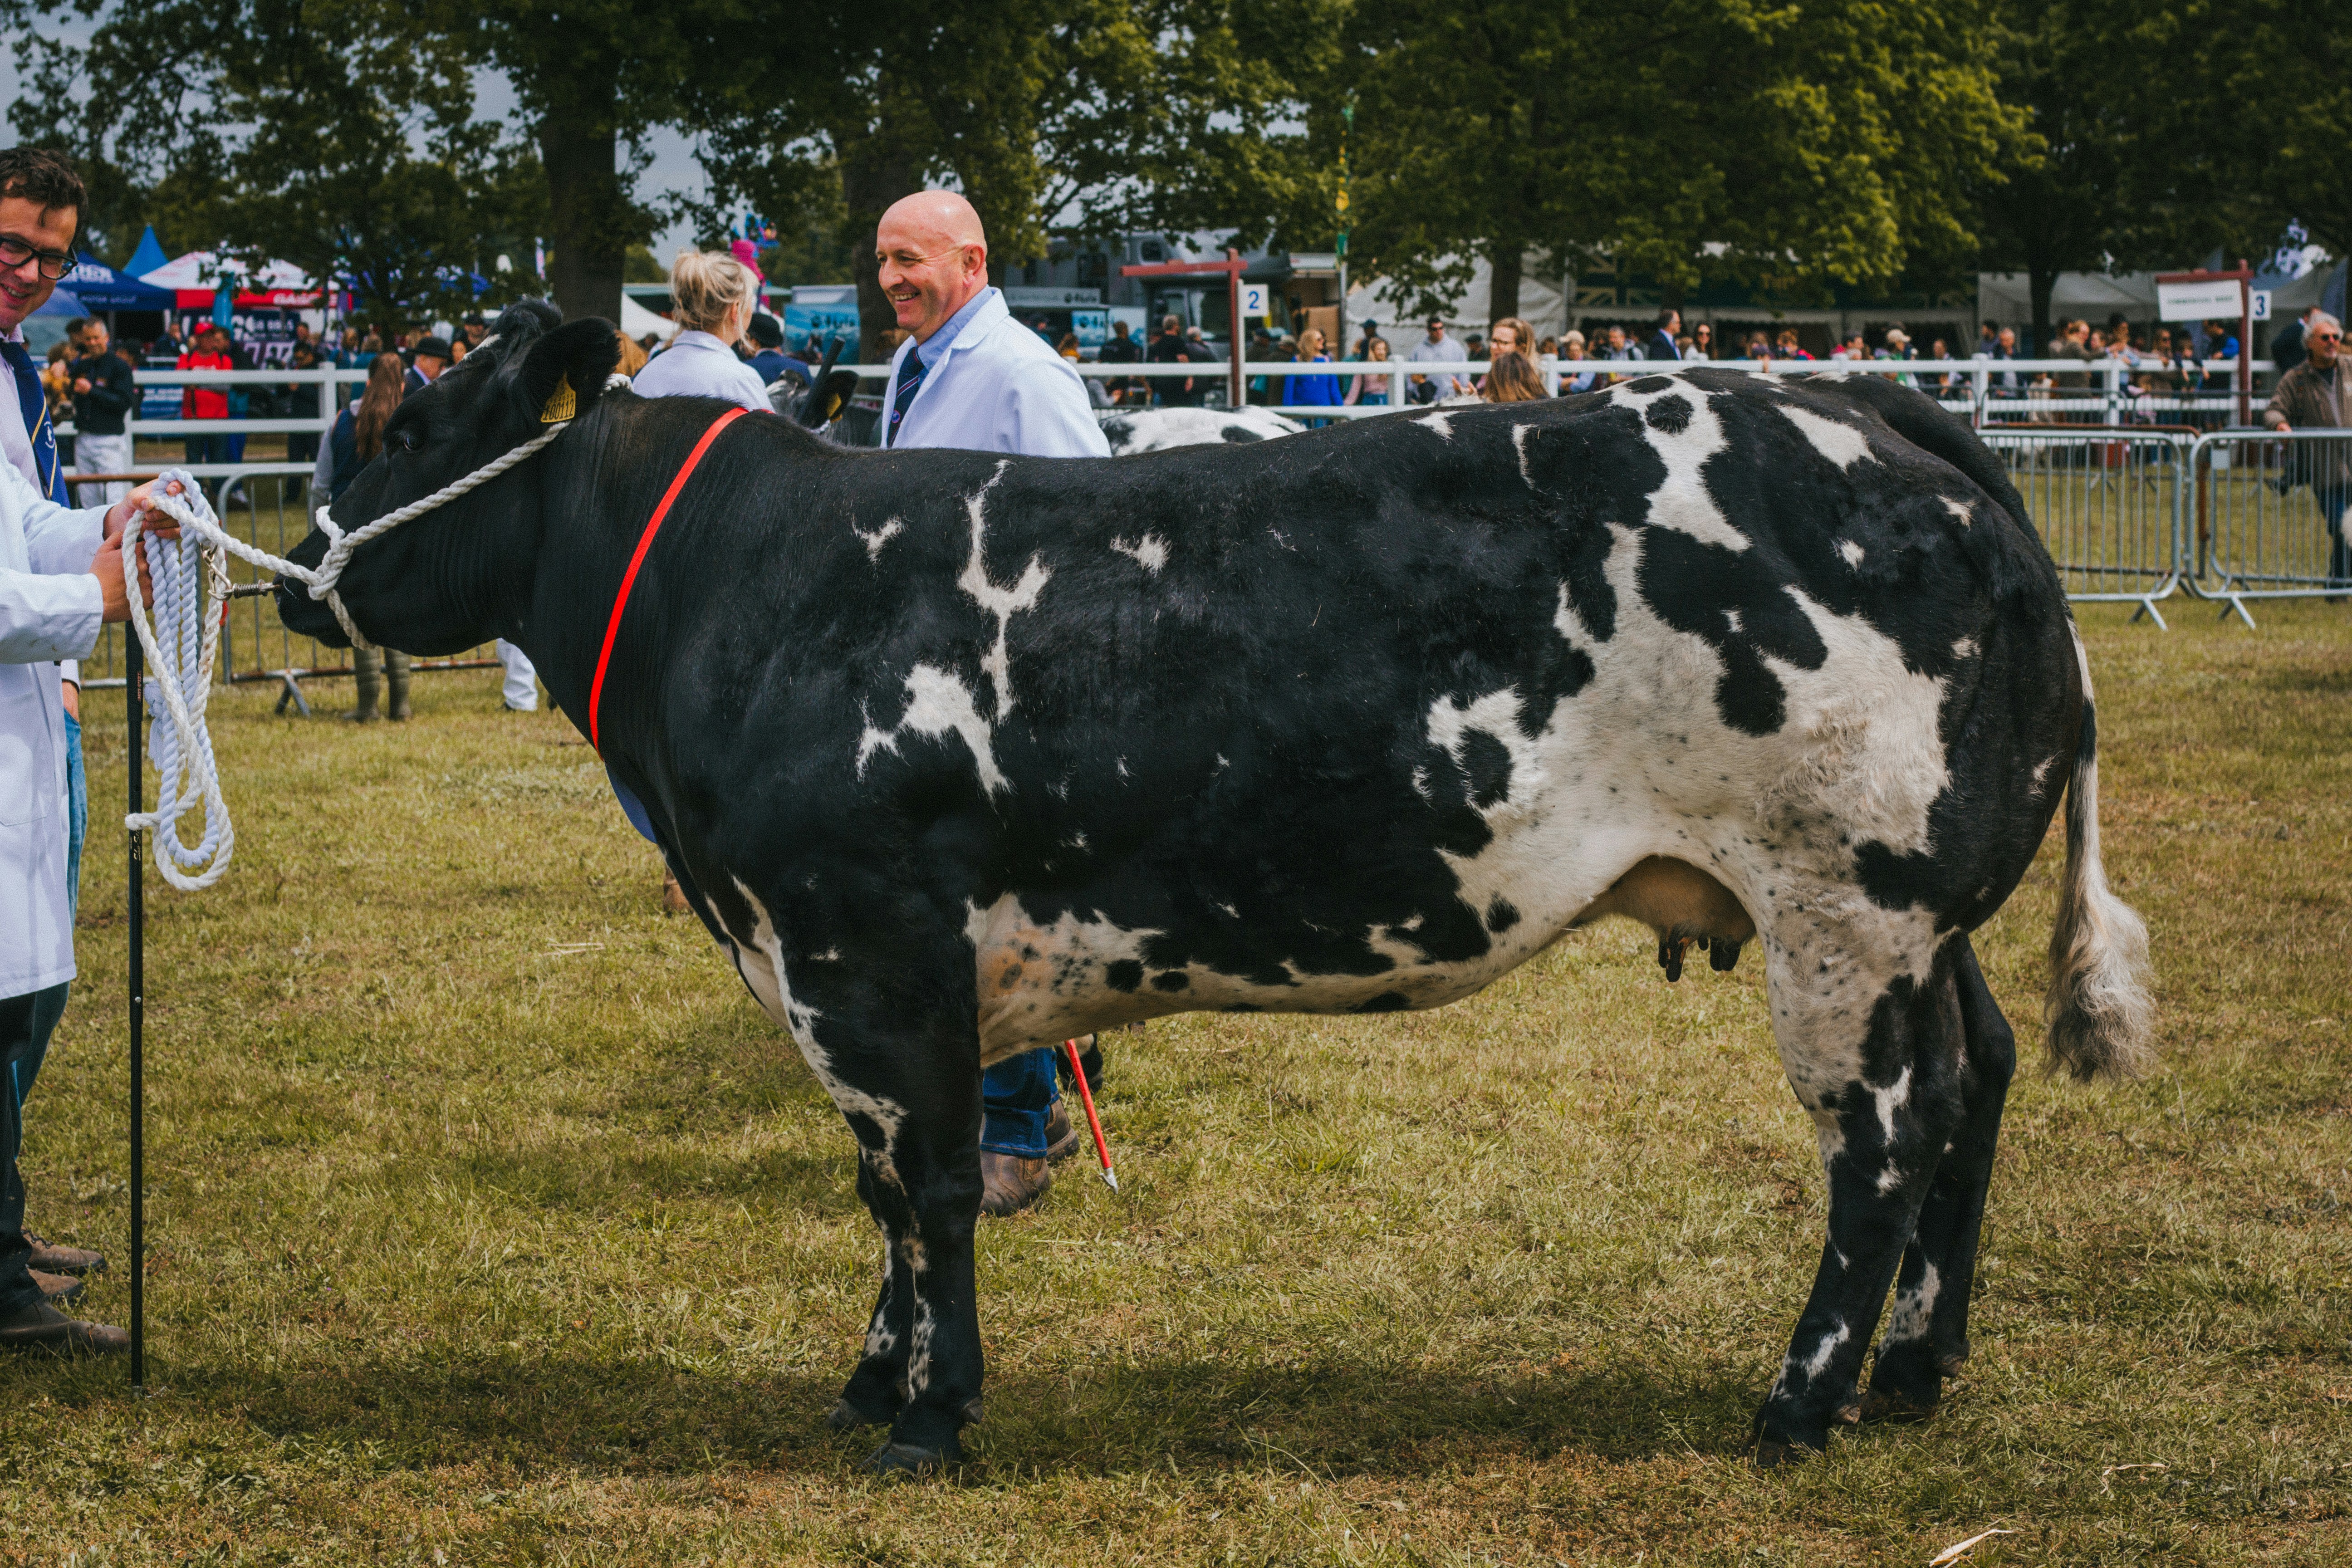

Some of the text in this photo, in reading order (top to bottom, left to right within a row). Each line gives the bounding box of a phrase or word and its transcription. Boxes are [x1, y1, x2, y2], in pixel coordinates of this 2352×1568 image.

[1249, 291, 1259, 309] 2
[2255, 296, 2265, 316] 3
[543, 398, 574, 420] 100112
